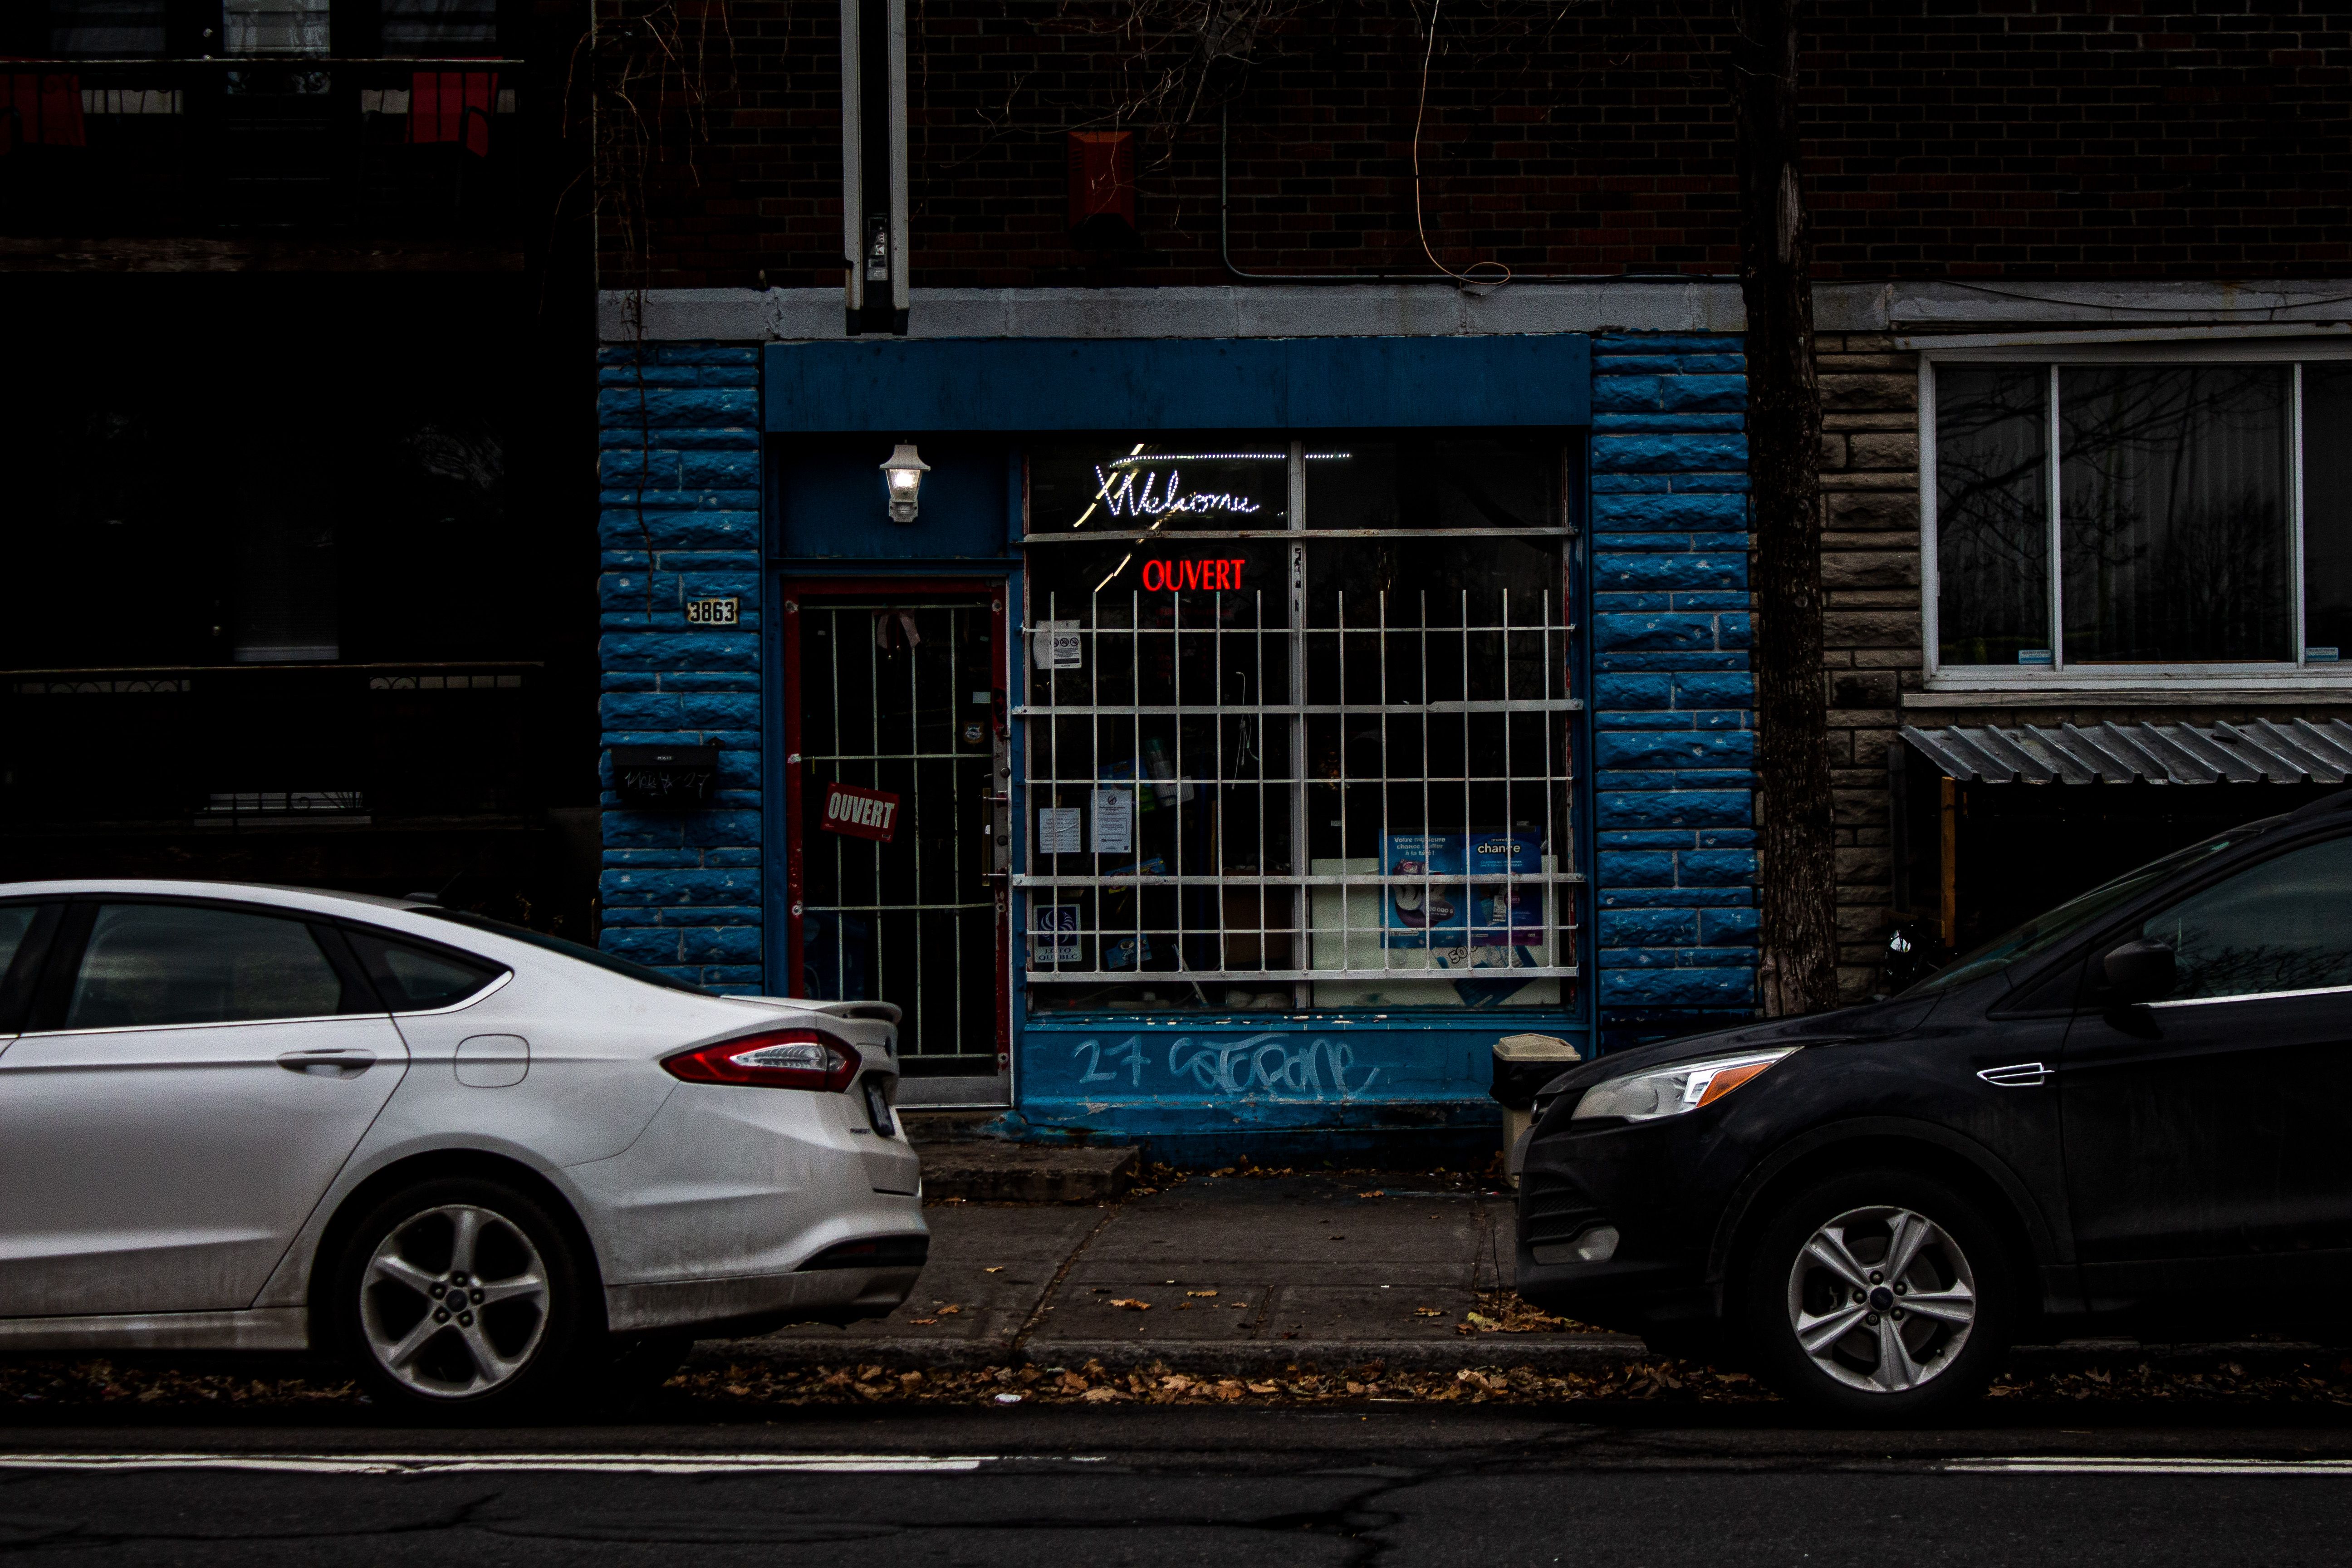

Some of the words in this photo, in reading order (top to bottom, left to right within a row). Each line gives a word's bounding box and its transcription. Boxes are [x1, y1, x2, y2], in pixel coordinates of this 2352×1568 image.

[1095, 465, 1260, 516] Welcome
[1142, 559, 1245, 591] OUVERT
[690, 601, 735, 622] 3863
[828, 792, 895, 829] OUVERT
